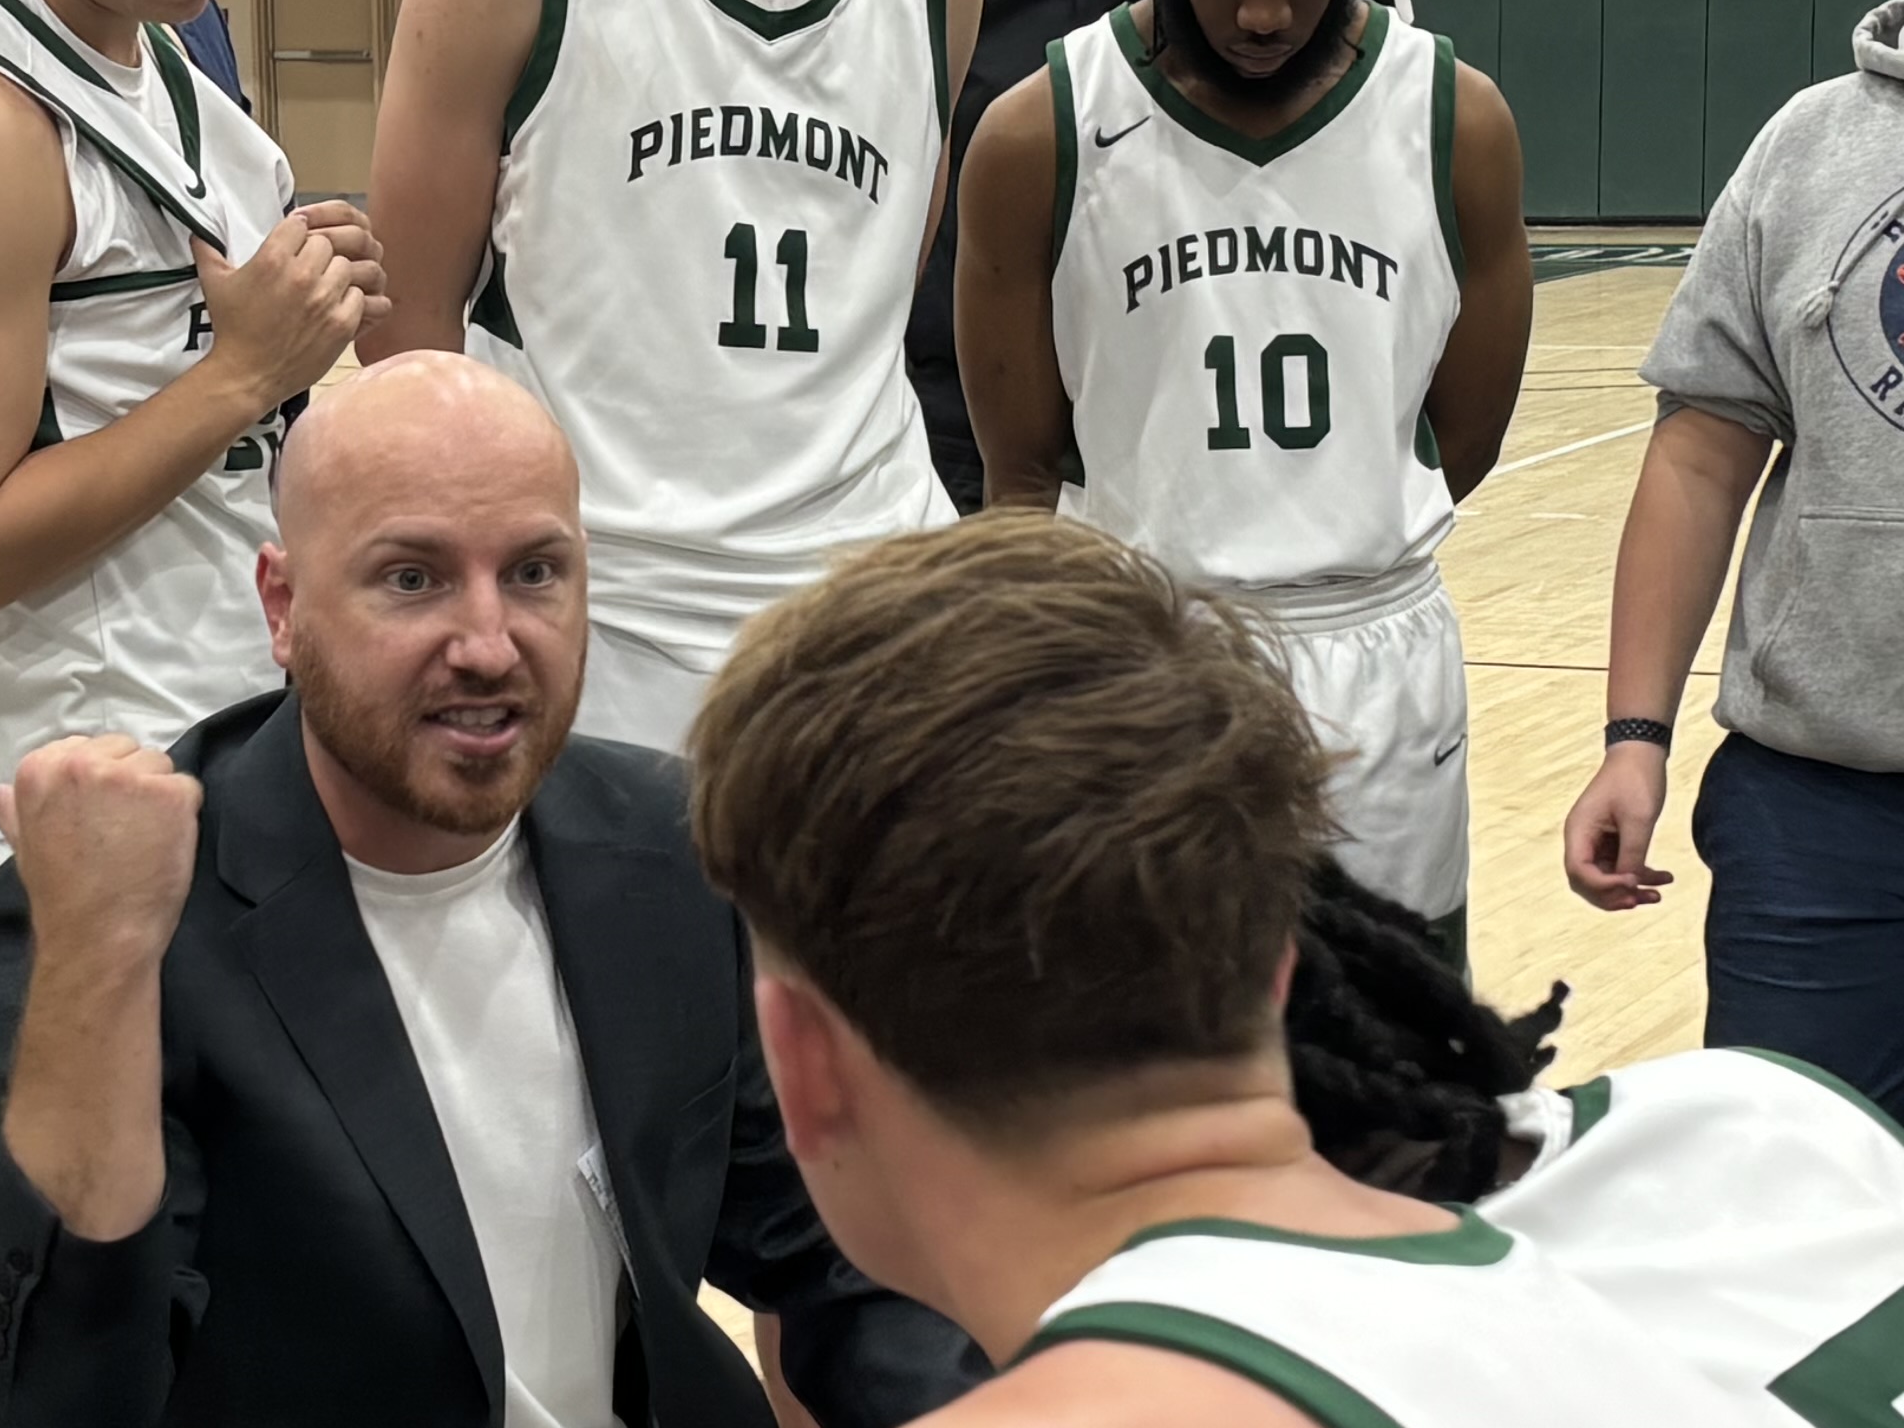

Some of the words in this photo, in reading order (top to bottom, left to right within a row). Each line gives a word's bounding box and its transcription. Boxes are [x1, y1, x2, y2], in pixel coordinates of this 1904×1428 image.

[628, 104, 889, 205] PIEDMONT
[717, 223, 820, 353] 11
[1122, 224, 1398, 313] PIEDMONT
[1204, 333, 1332, 450] 10
